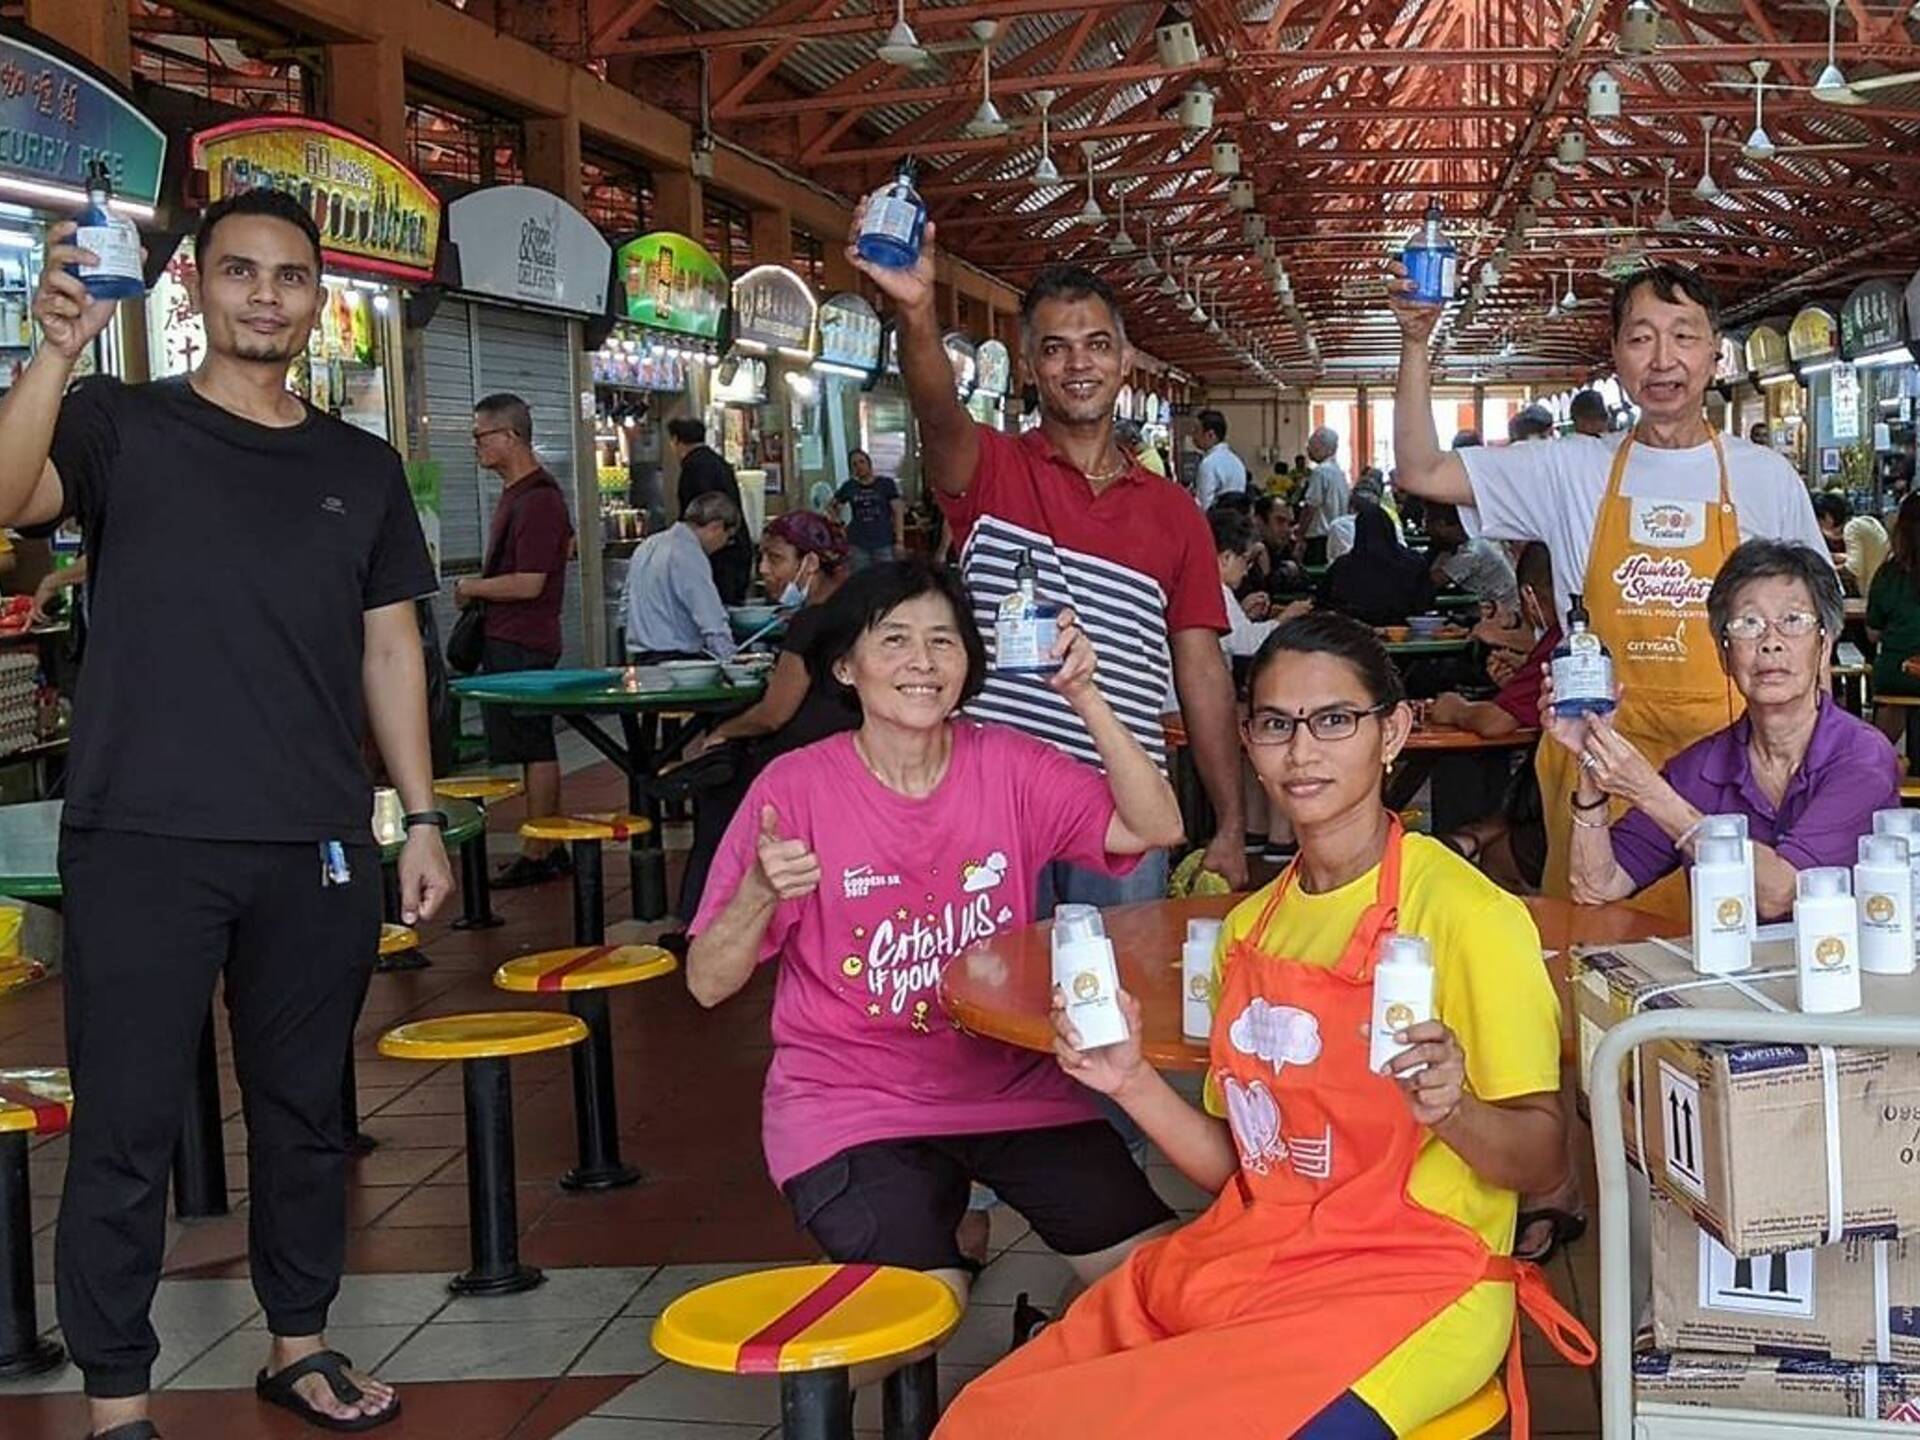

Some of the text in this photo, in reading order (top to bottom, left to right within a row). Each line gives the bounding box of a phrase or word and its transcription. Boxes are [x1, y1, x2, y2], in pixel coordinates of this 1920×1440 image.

[78, 144, 124, 186] RCE
[1615, 555, 1688, 581] Hawker
[1624, 576, 1713, 605] Spotlight
[1626, 640, 1678, 653] CITYGAS
